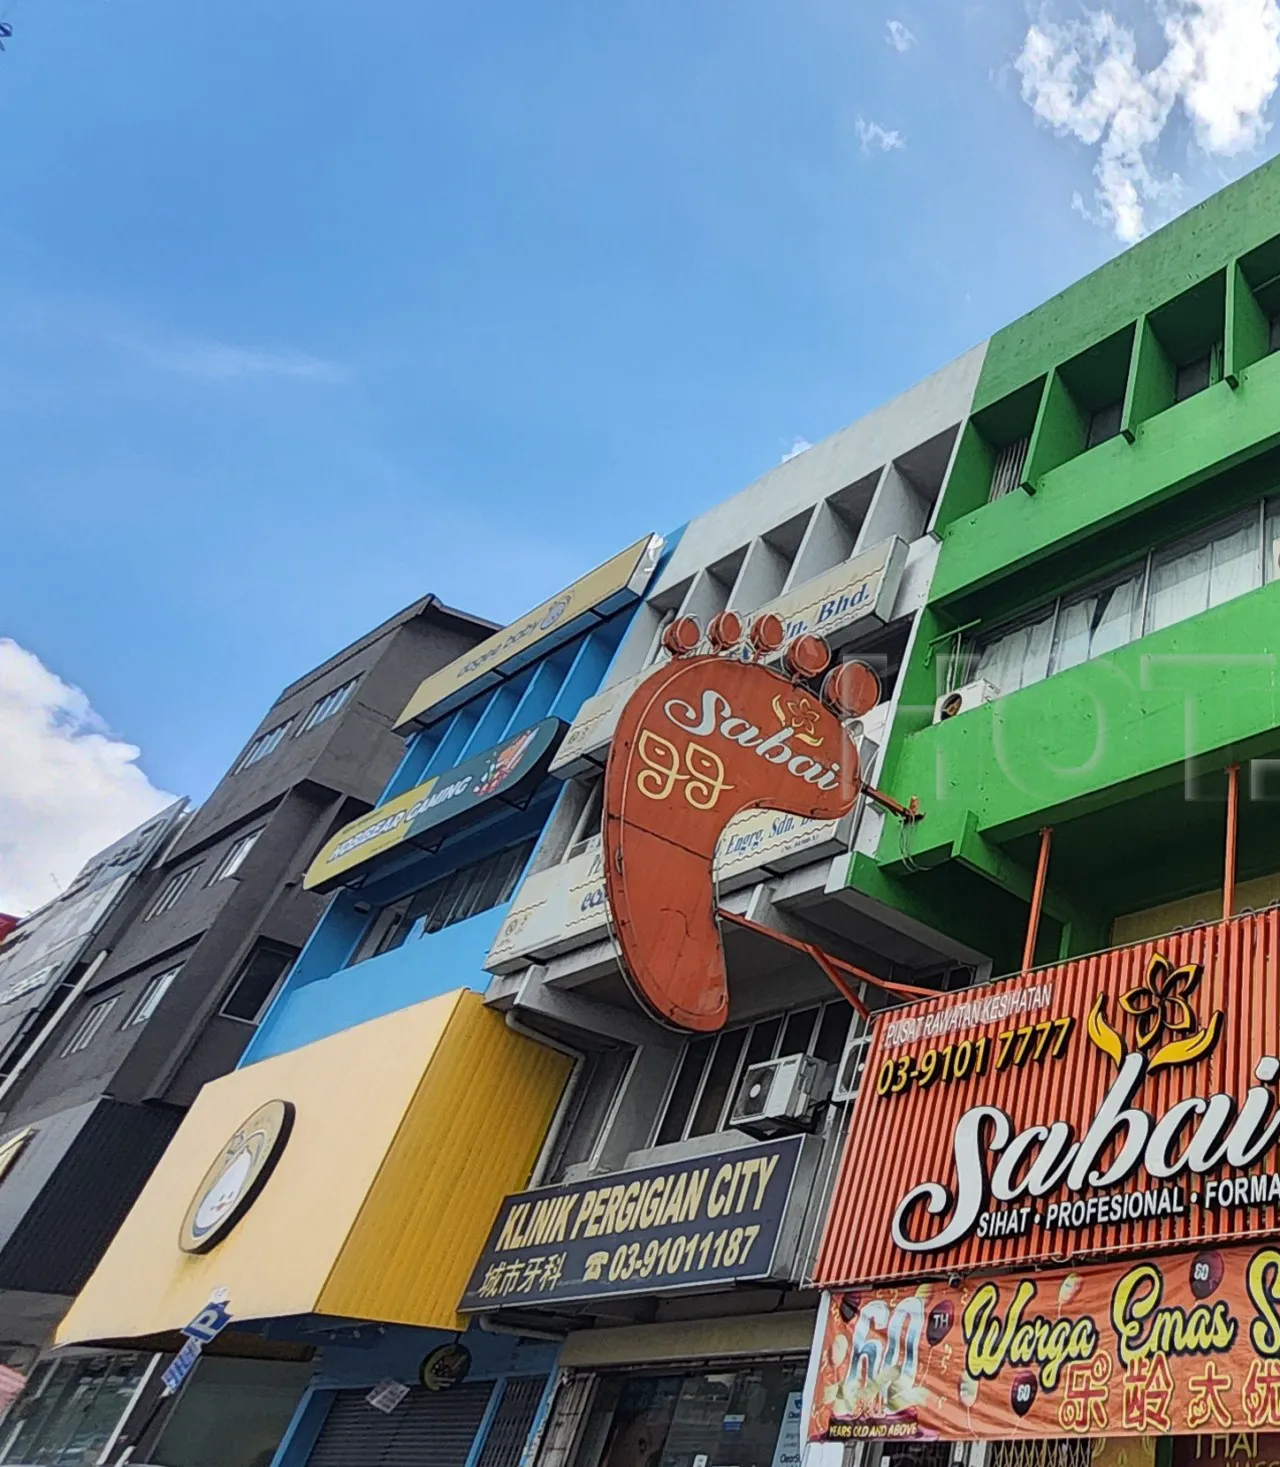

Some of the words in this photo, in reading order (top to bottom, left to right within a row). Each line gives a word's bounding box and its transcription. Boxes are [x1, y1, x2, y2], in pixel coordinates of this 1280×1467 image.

[817, 583, 869, 624] Bhd.
[664, 690, 842, 791] Sabai
[405, 775, 473, 822] GAMING
[884, 1017, 923, 1048] PUSAT
[923, 1002, 981, 1036] RAWATAN
[980, 983, 1053, 1019] KESIHATAN
[877, 1037, 986, 1096] 03-9101
[995, 1017, 1071, 1070] 7777
[495, 1193, 580, 1252] KLINIK
[570, 1168, 709, 1240] PERGIGIAN
[707, 1155, 780, 1219] CITY
[976, 1207, 1029, 1239] SIHAT
[1045, 1193, 1184, 1230] PROFESIONAL
[477, 1252, 568, 1299] 城市牙科
[608, 1225, 760, 1282] 03-91011187
[190, 1309, 219, 1338] P
[933, 1314, 949, 1328] TH
[964, 1281, 1096, 1389] Warga
[1112, 1265, 1235, 1362] Emas
[844, 1296, 925, 1402] 60
[1016, 1384, 1031, 1402] 60
[829, 1425, 851, 1437] YEARS
[853, 1425, 869, 1437] OLD
[869, 1424, 887, 1436] AND
[887, 1422, 917, 1436] ABOVE
[1196, 1432, 1258, 1459] THAI
